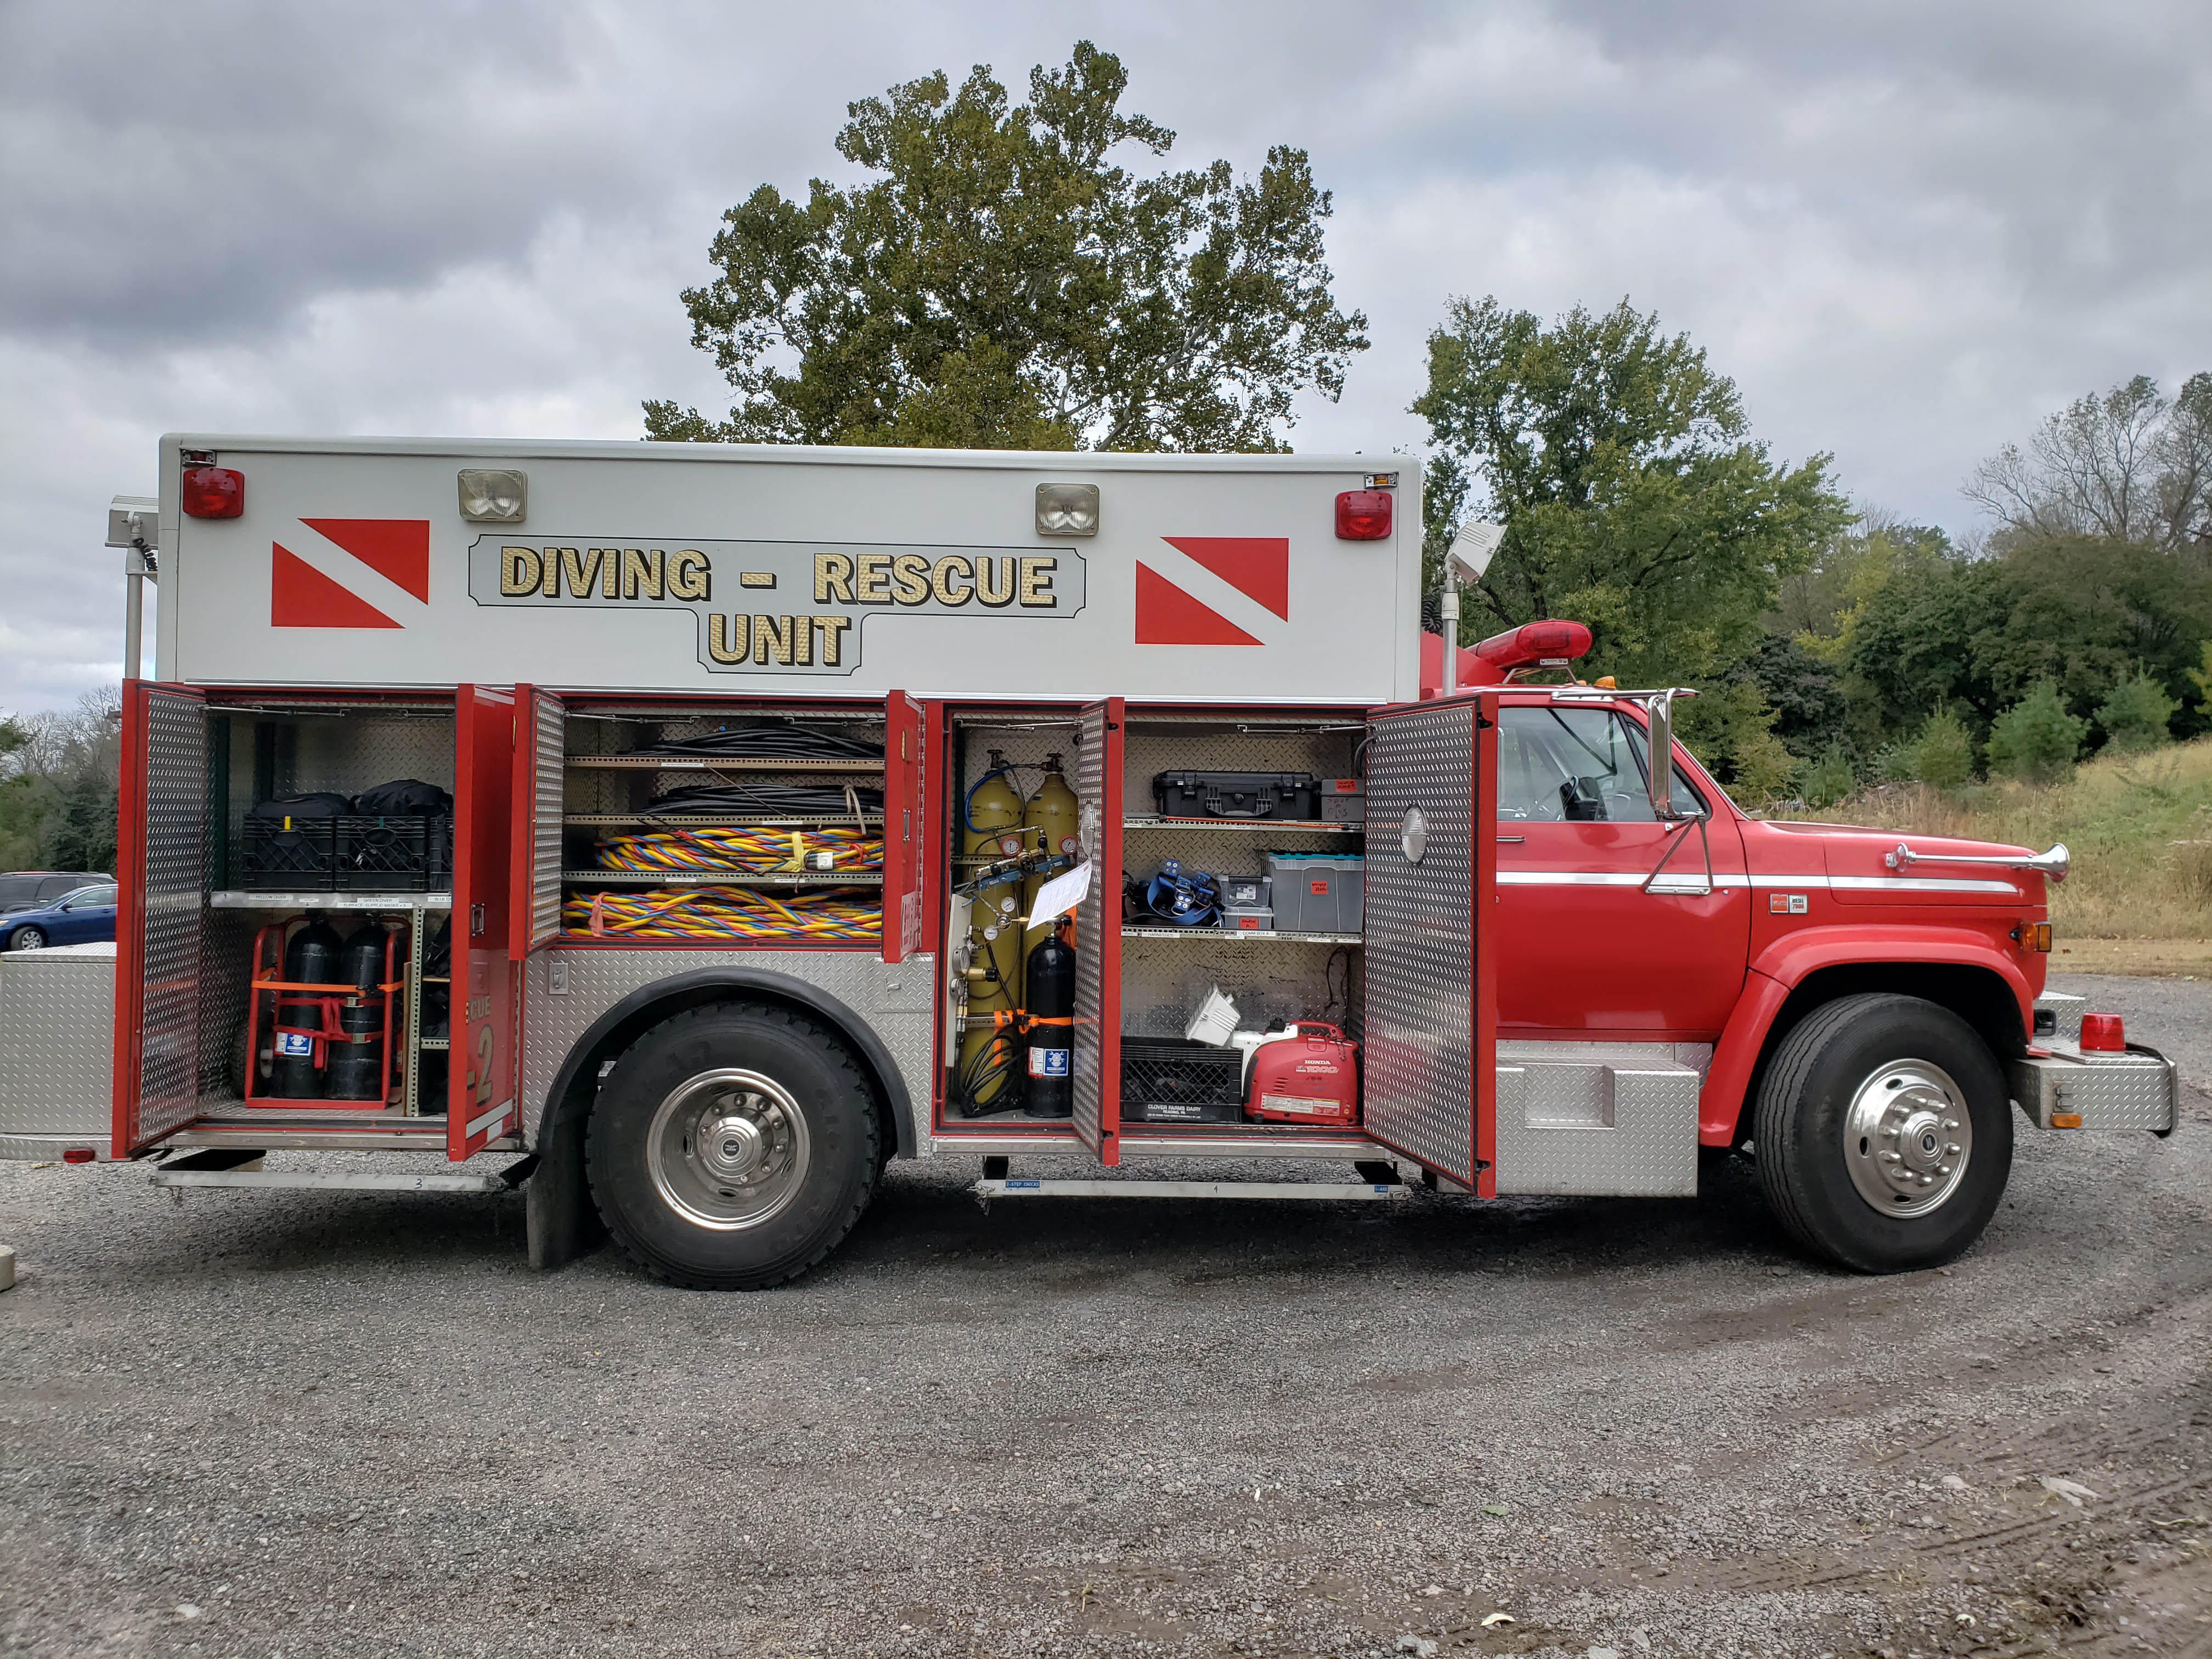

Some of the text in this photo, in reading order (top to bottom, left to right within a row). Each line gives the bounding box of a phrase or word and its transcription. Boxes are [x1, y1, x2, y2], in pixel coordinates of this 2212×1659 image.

[500, 546, 1057, 608] DIVING - RESCUE
[709, 613, 851, 667] UNIT
[414, 1178, 422, 1189] 3
